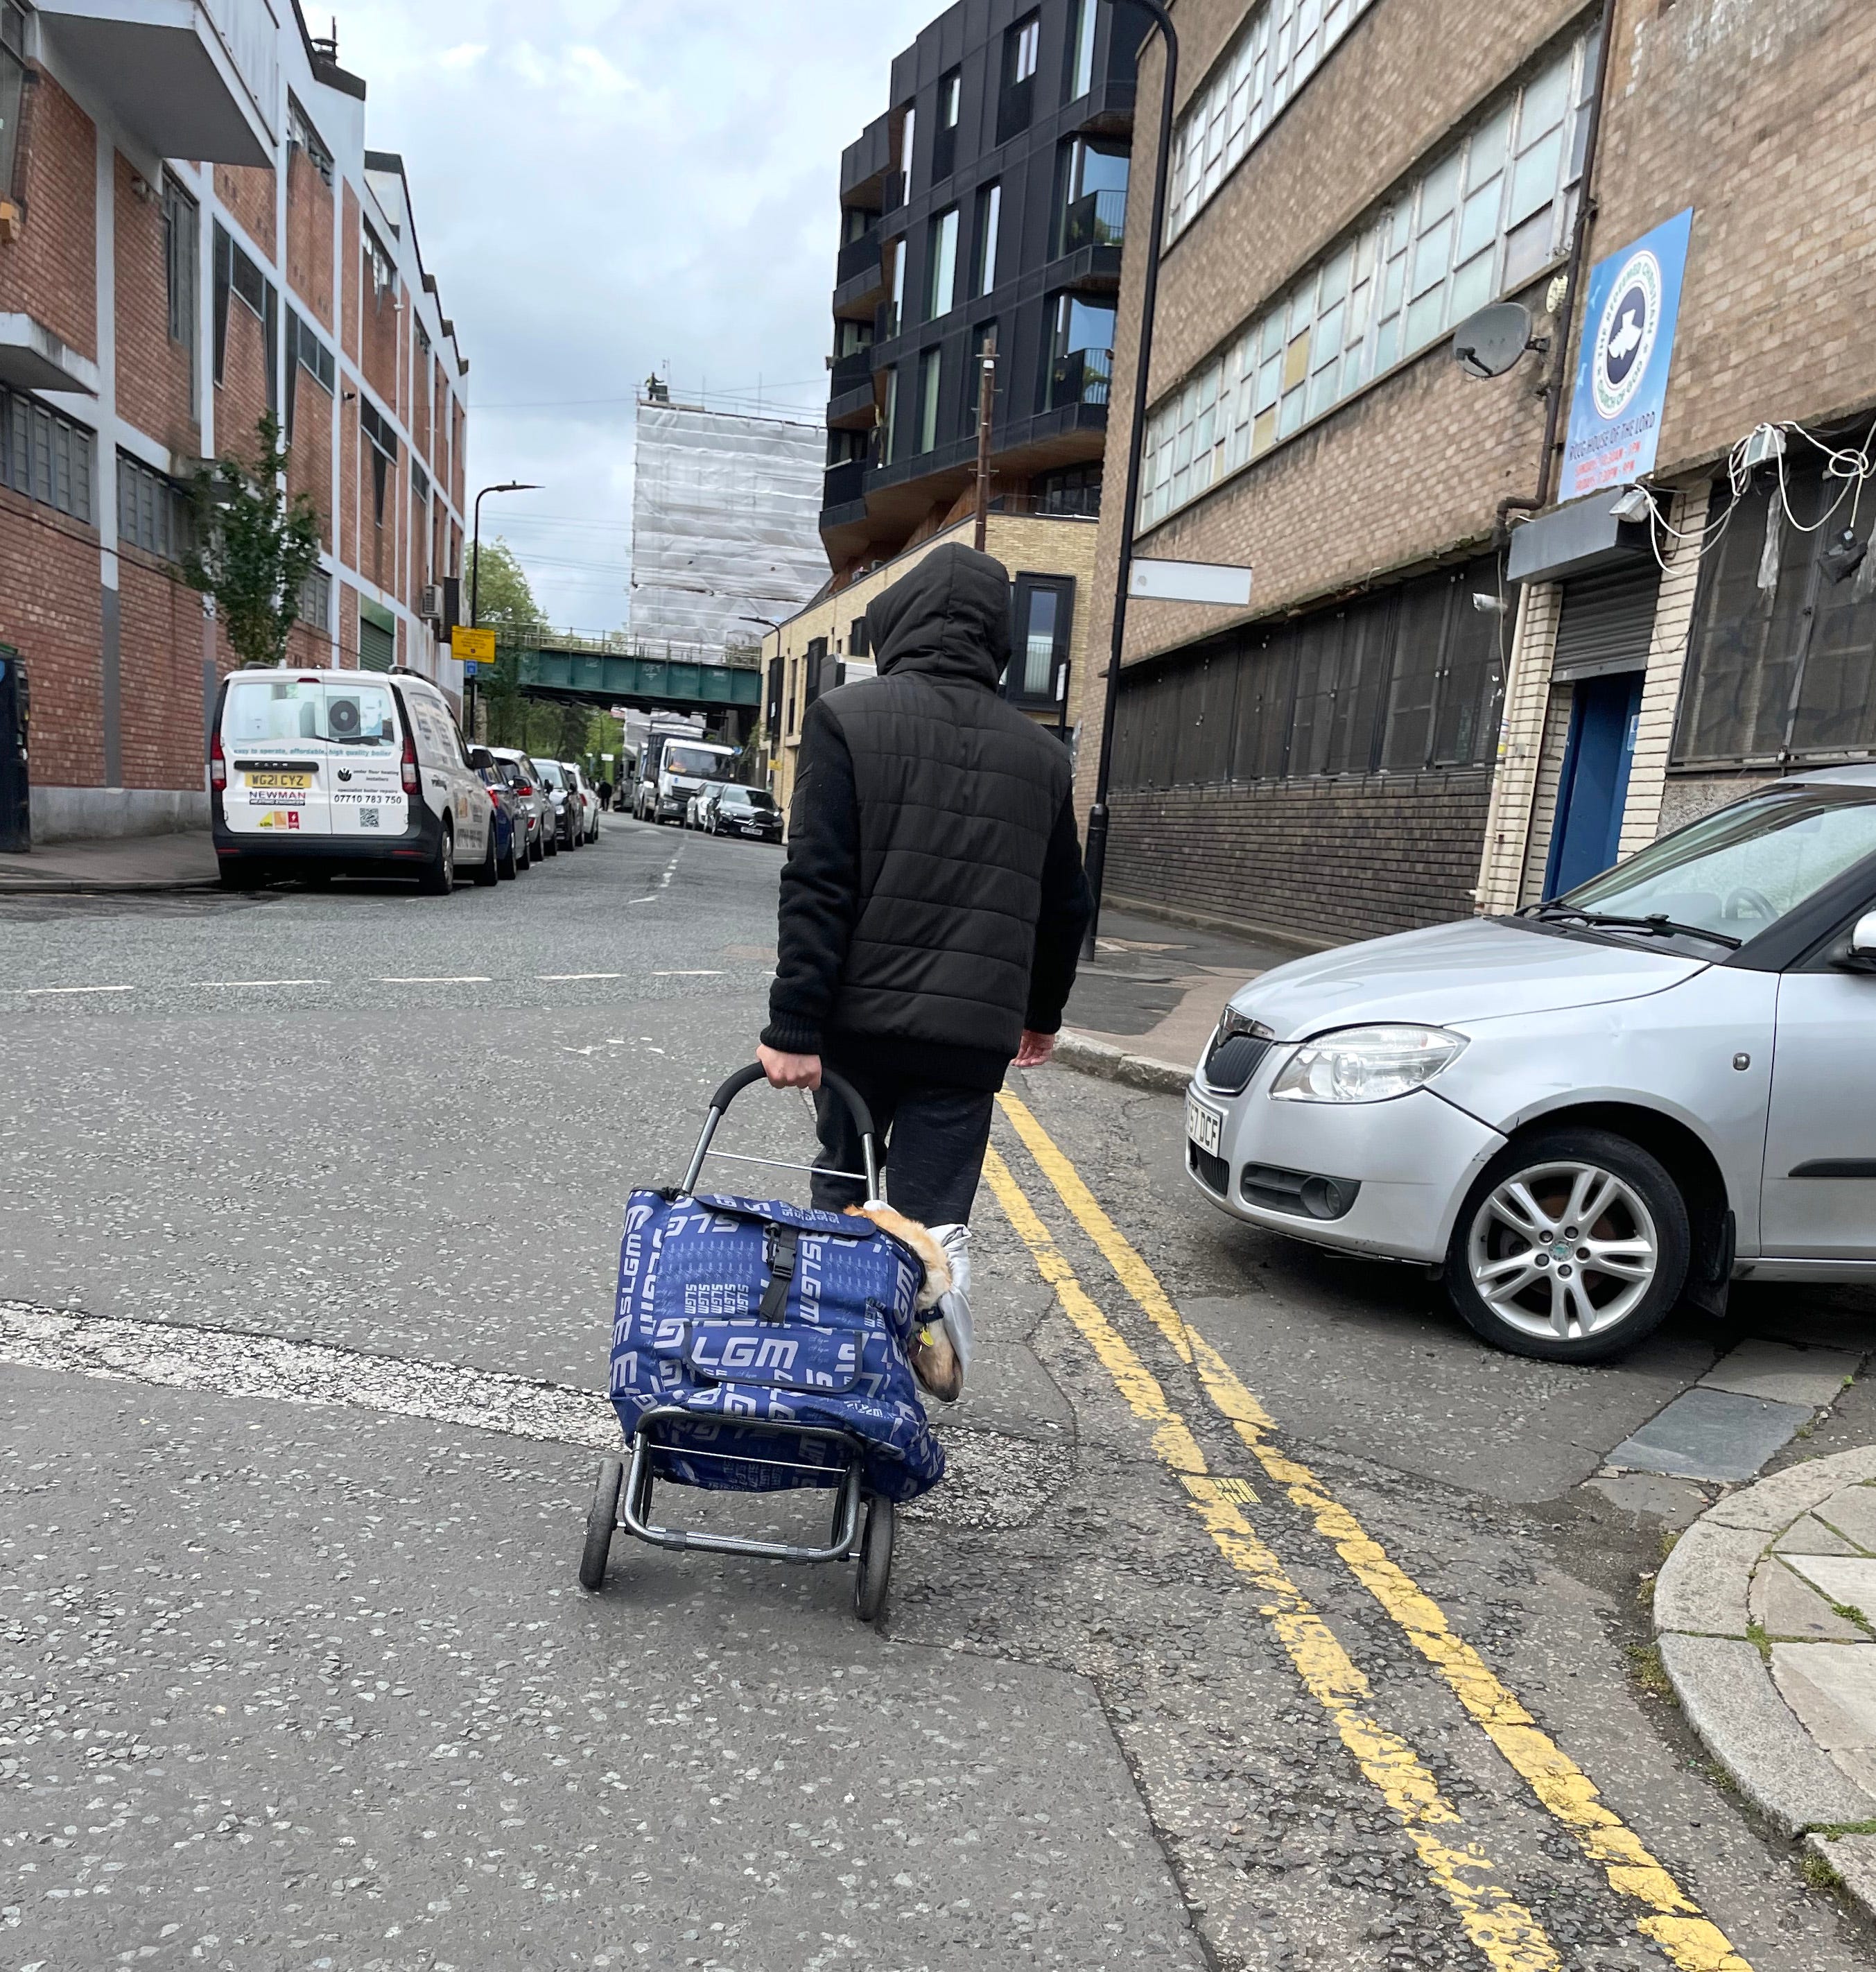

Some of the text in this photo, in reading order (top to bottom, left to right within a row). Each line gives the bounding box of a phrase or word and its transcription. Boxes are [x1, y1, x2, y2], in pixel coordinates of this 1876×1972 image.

[1586, 430, 1610, 454] HOUSE
[1610, 424, 1621, 444] OF
[1622, 419, 1635, 440] THE
[1635, 410, 1656, 435] LORD
[250, 790, 306, 799] NEWMAN
[252, 775, 304, 786] WG21 CYZ
[334, 795, 362, 803] 07710
[385, 796, 401, 804] 750
[1199, 1111, 1218, 1150] DCF
[799, 1240, 822, 1324] SLGM
[684, 1283, 697, 1315] SLGM
[697, 1283, 711, 1314] SLGM
[711, 1283, 723, 1314] SLGM
[691, 1337, 799, 1369] LGM
